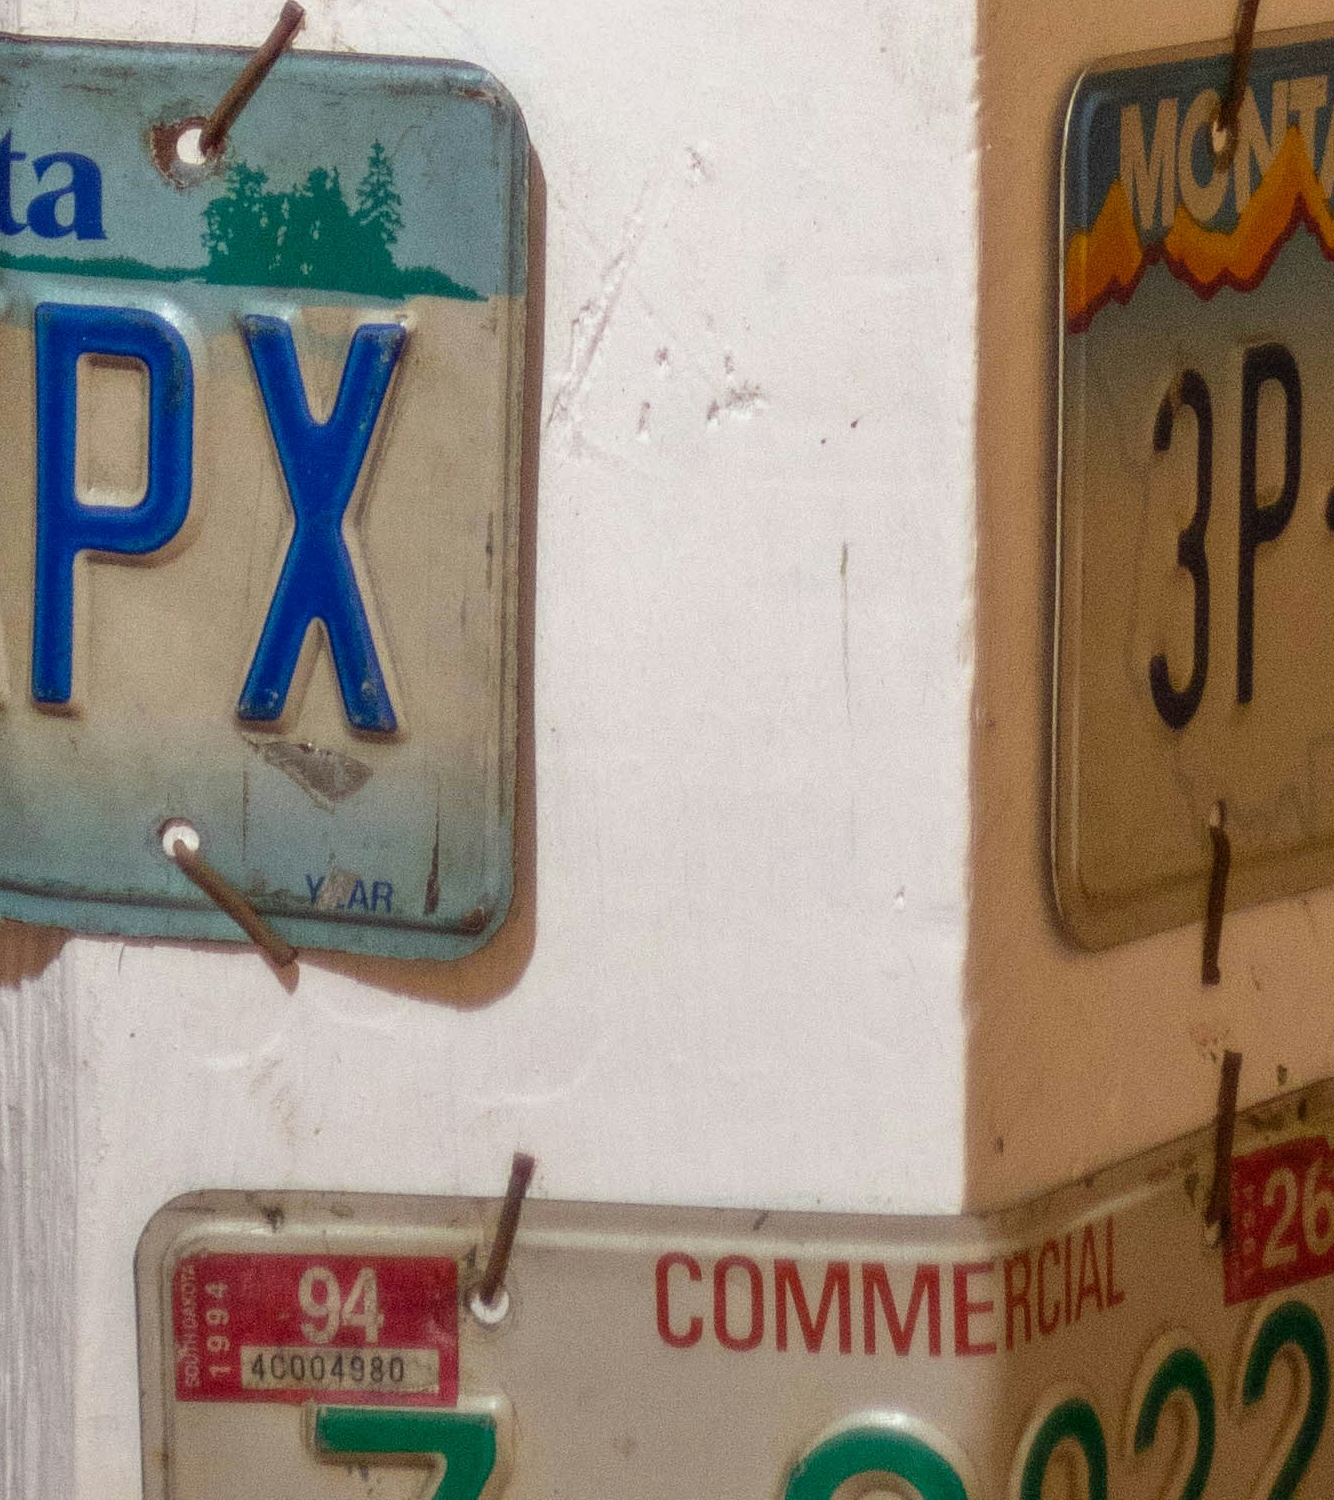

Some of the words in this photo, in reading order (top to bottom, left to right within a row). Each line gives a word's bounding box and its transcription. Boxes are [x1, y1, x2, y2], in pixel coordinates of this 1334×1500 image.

[304, 873, 395, 915] YAR
[203, 1280, 231, 1378] 1994
[297, 1265, 385, 1344] 94
[654, 1216, 1126, 1358] COMMERCIAL
